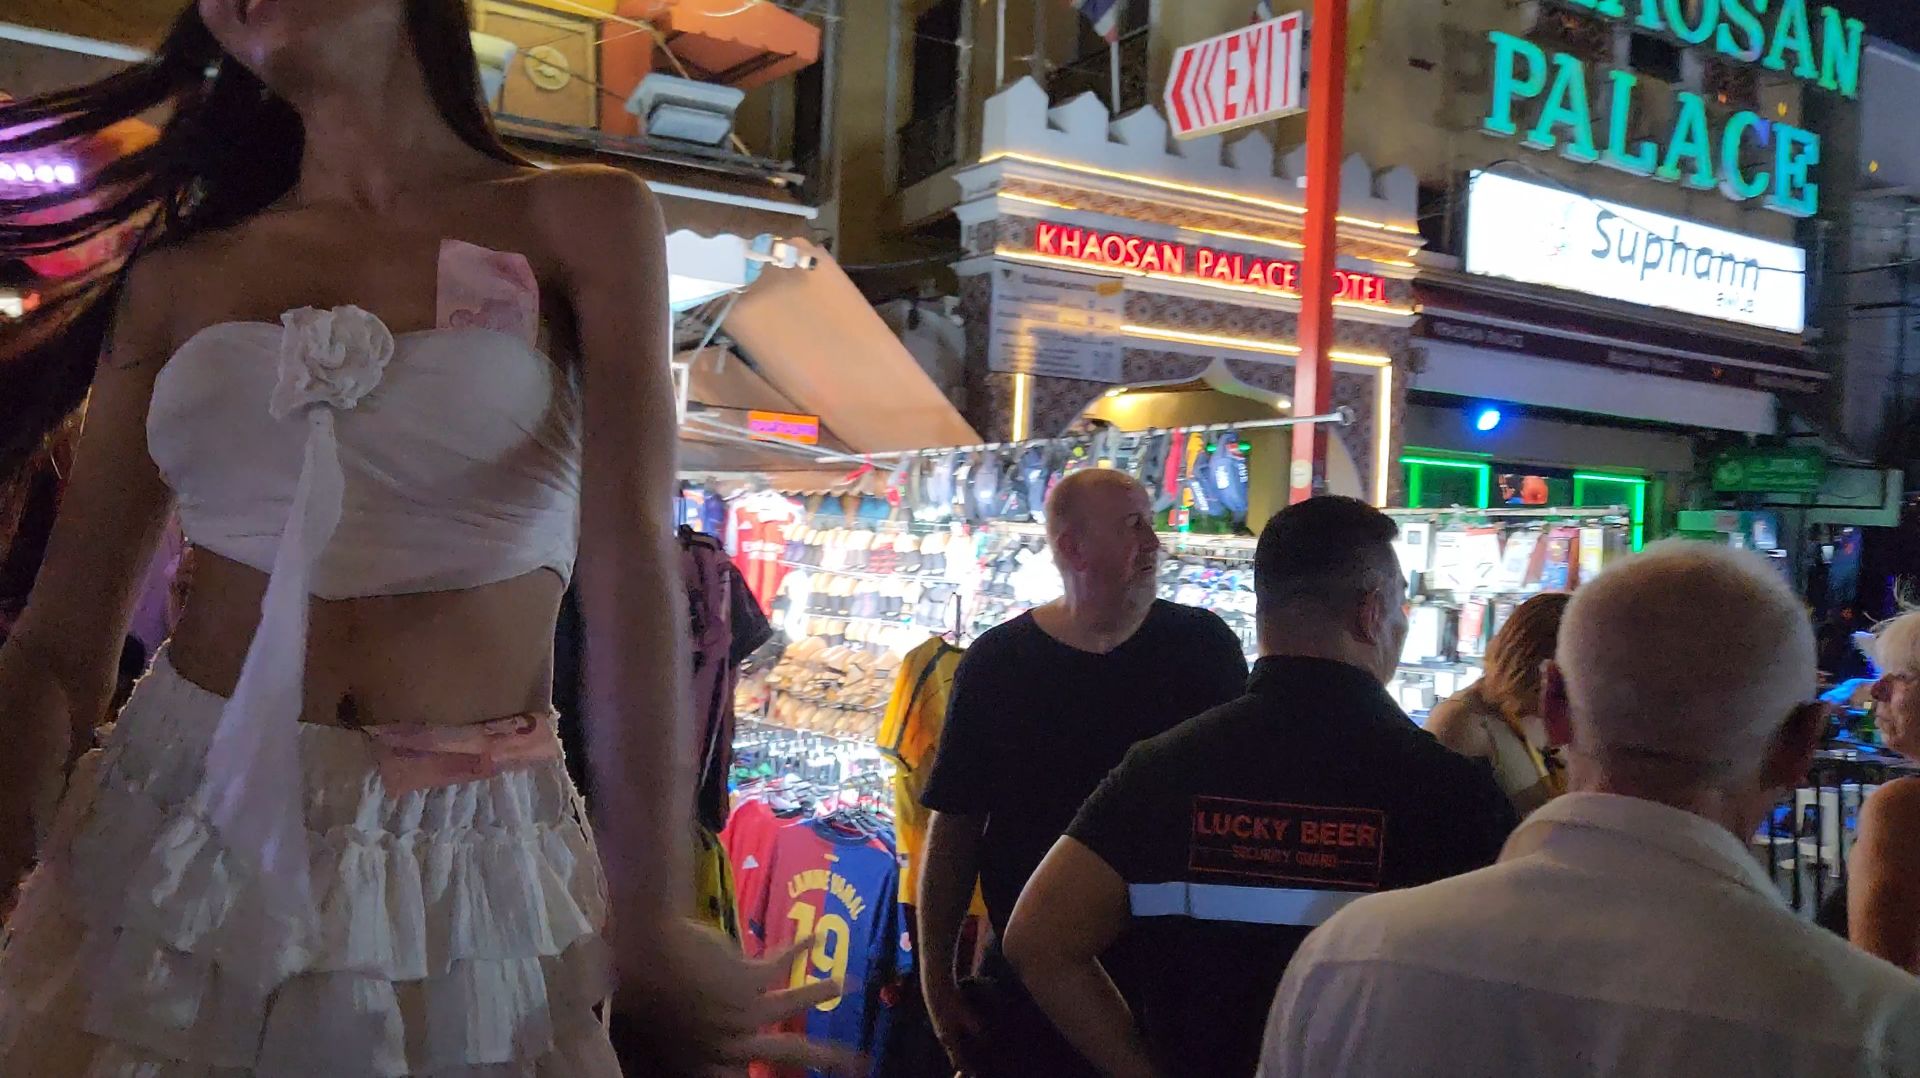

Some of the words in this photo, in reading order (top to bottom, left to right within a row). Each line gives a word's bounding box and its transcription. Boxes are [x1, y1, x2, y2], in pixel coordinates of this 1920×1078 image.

[1223, 16, 1298, 121] EXIT
[1483, 31, 1821, 215] PALACE
[1037, 222, 1185, 275] KHAOSAN
[1197, 248, 1298, 291] PALACE
[1332, 270, 1389, 303] OTEL
[1196, 811, 1289, 841] LUCKY
[1299, 820, 1377, 847] BEER
[786, 901, 850, 1012] 19
